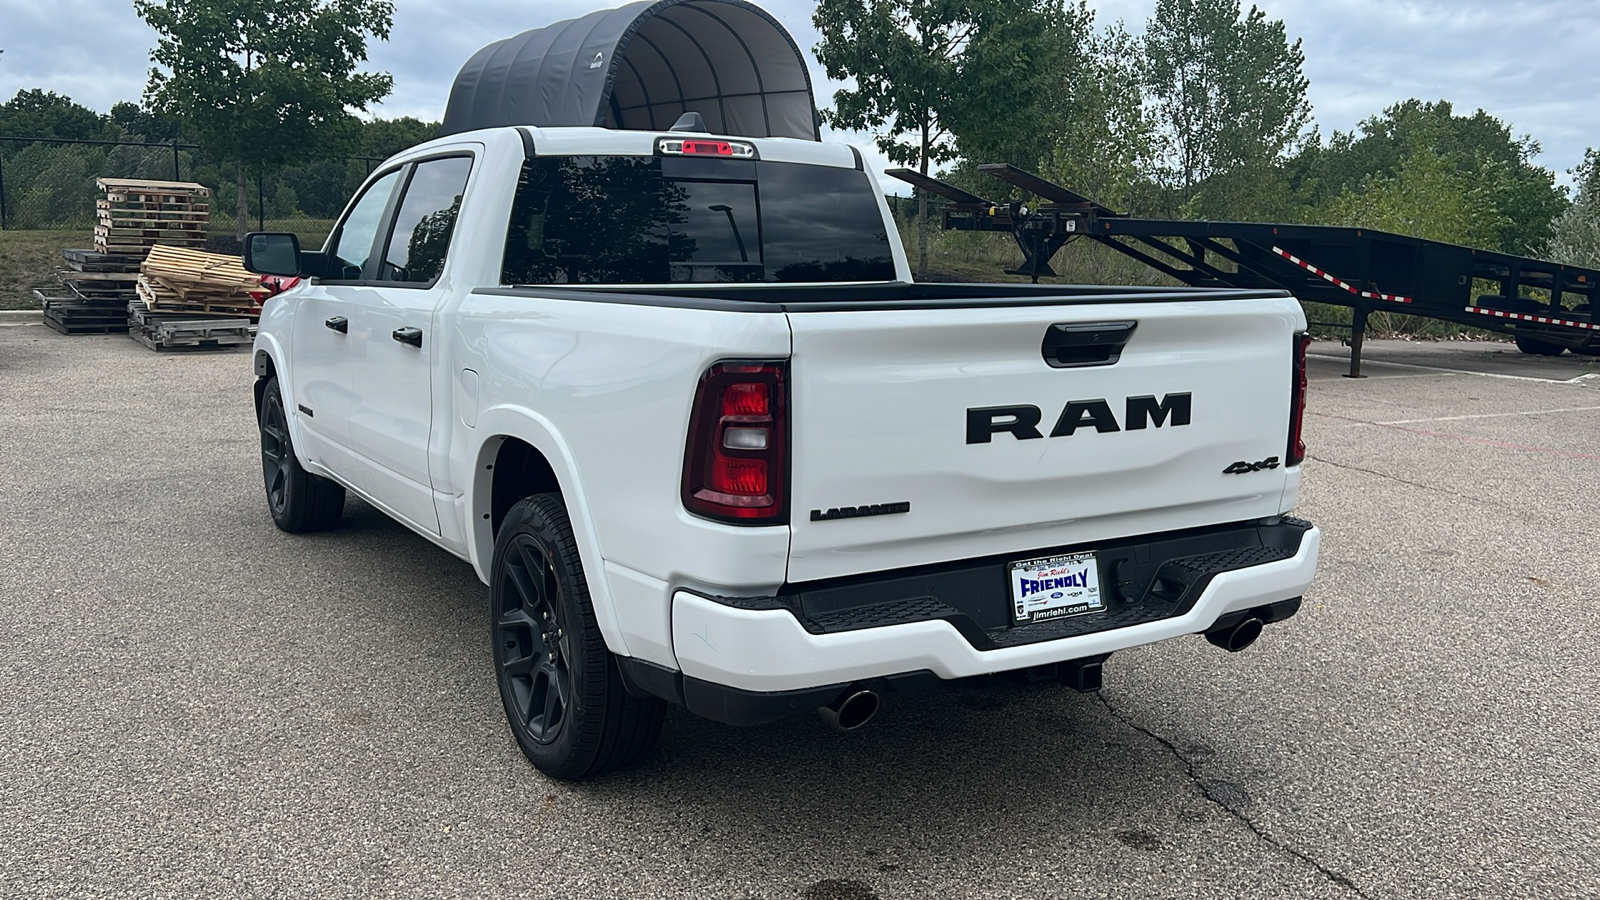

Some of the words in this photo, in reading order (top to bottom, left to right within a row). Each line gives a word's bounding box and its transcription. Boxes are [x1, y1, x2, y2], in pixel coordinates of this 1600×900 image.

[966, 391, 1192, 444] RAM
[1073, 552, 1093, 560] Deal
[1020, 567, 1088, 598] FRIENDLY
[1037, 571, 1048, 579] Jim
[1033, 604, 1087, 621] jimriehl.com
